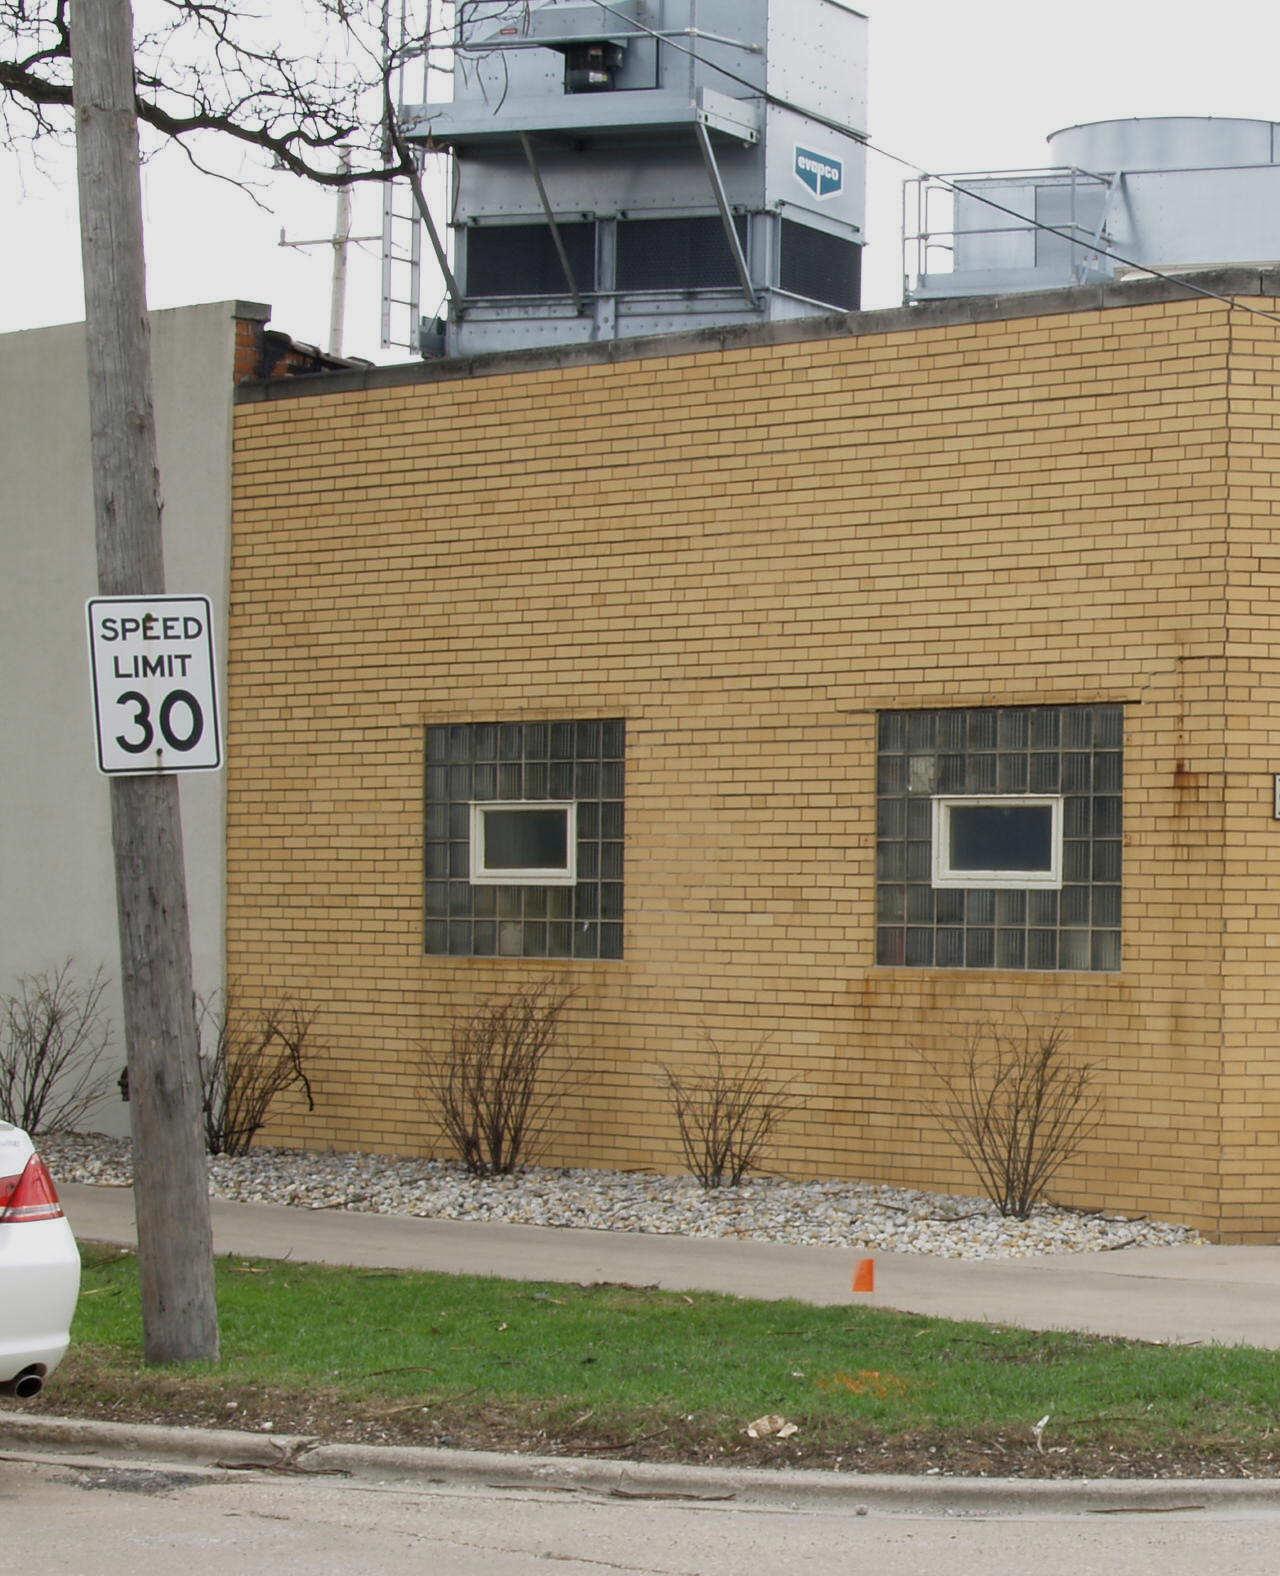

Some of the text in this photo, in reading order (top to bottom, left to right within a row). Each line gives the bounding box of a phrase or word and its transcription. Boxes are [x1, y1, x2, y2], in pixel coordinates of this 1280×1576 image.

[101, 616, 203, 642] SPEED
[113, 654, 192, 679] LIMIT
[115, 689, 204, 754] 30
